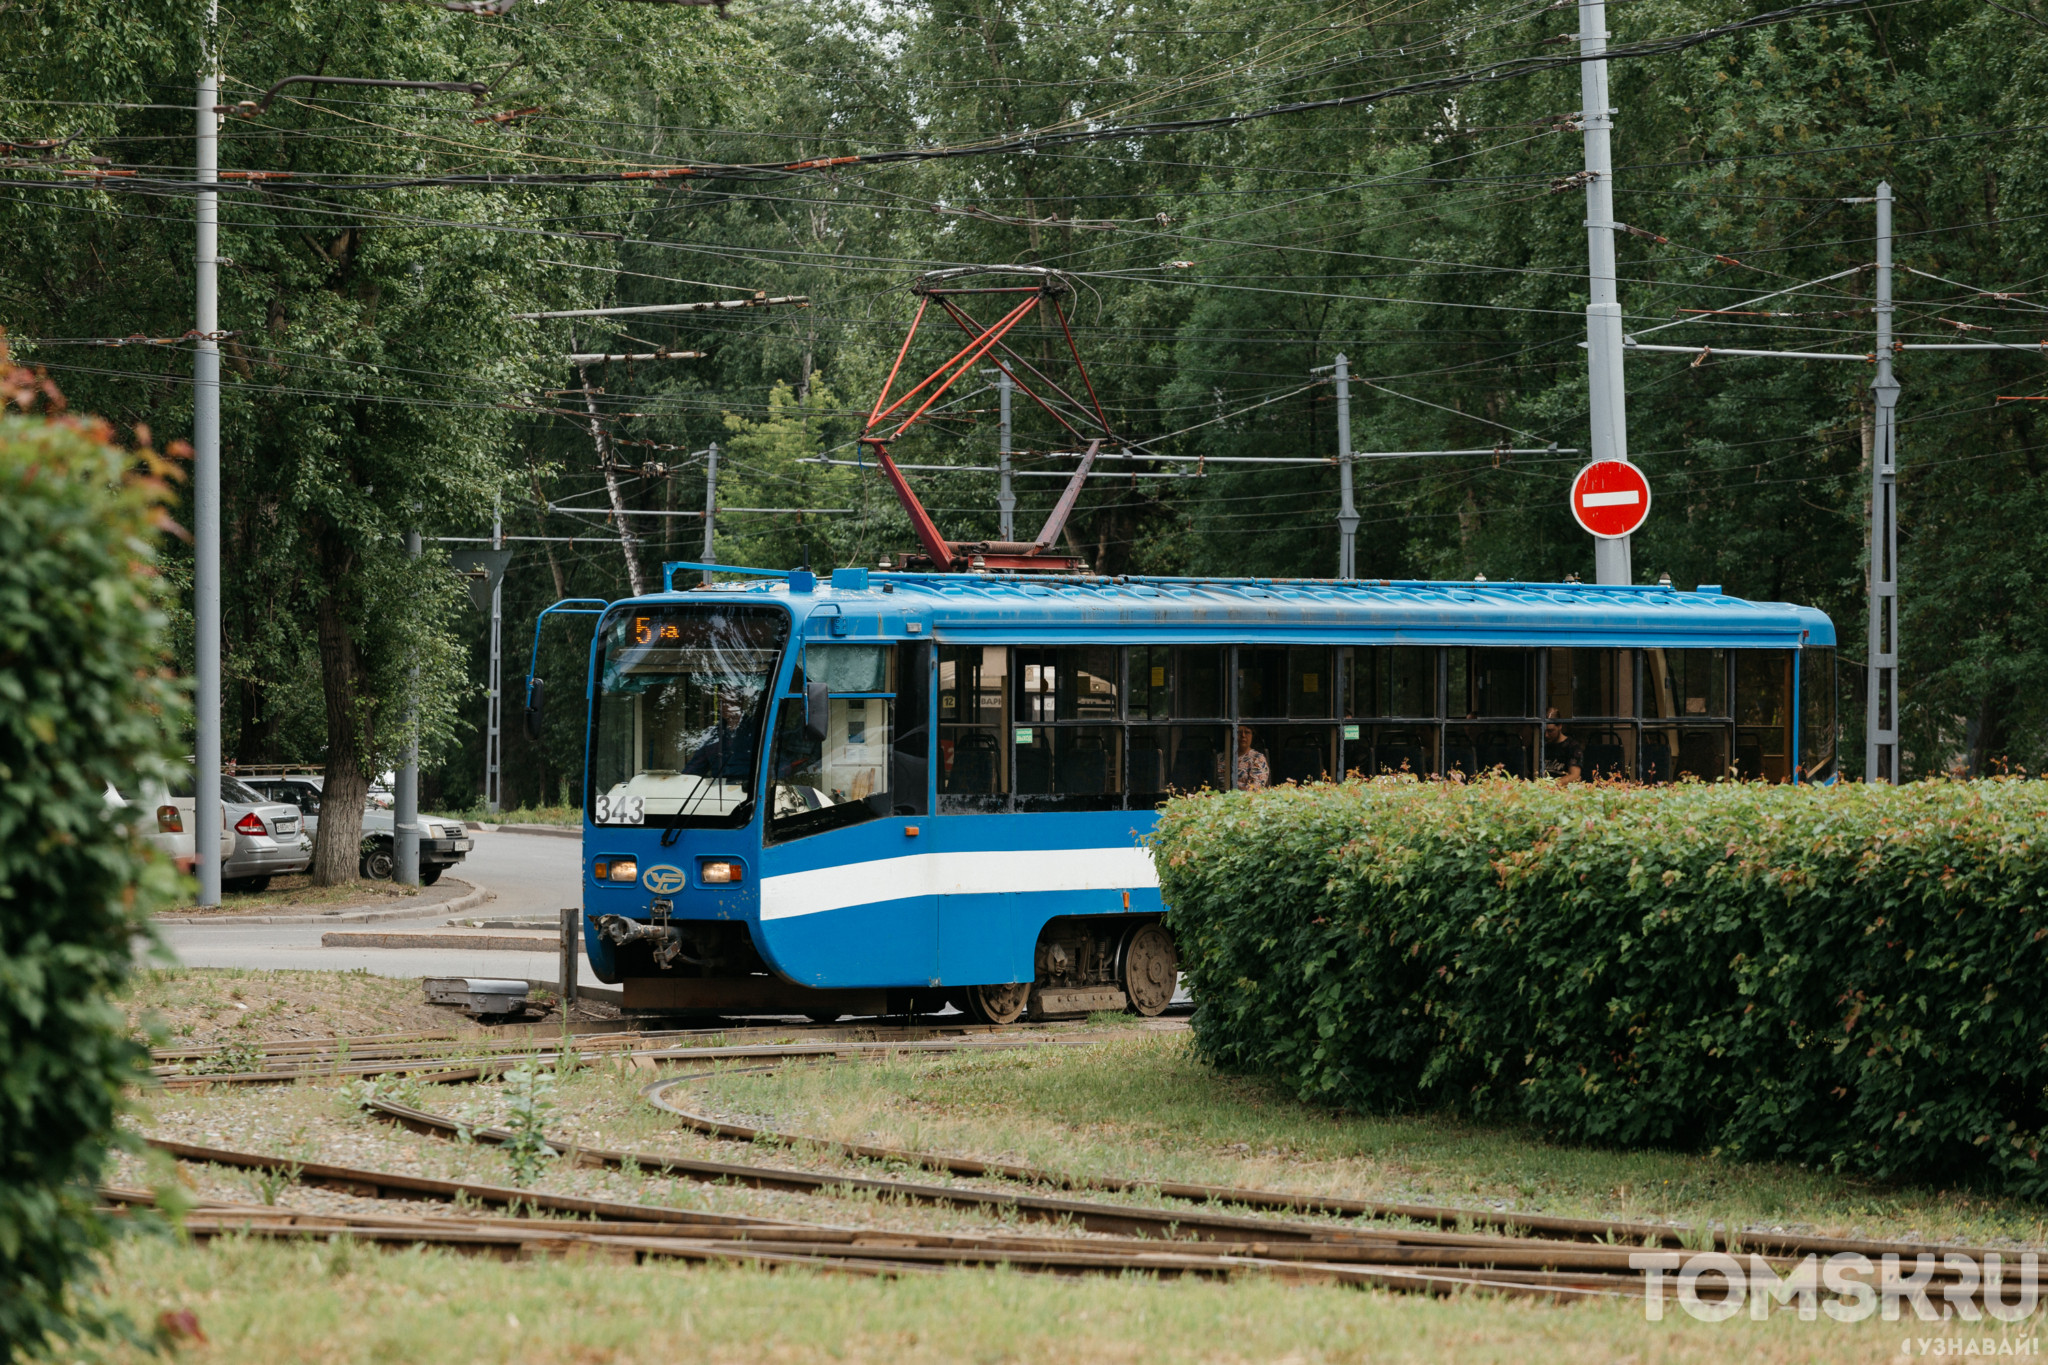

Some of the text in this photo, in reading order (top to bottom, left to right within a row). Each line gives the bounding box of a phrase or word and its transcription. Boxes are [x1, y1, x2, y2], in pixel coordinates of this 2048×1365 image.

[636, 617, 652, 644] 5
[944, 697, 954, 706] 12
[596, 796, 643, 824] 343
